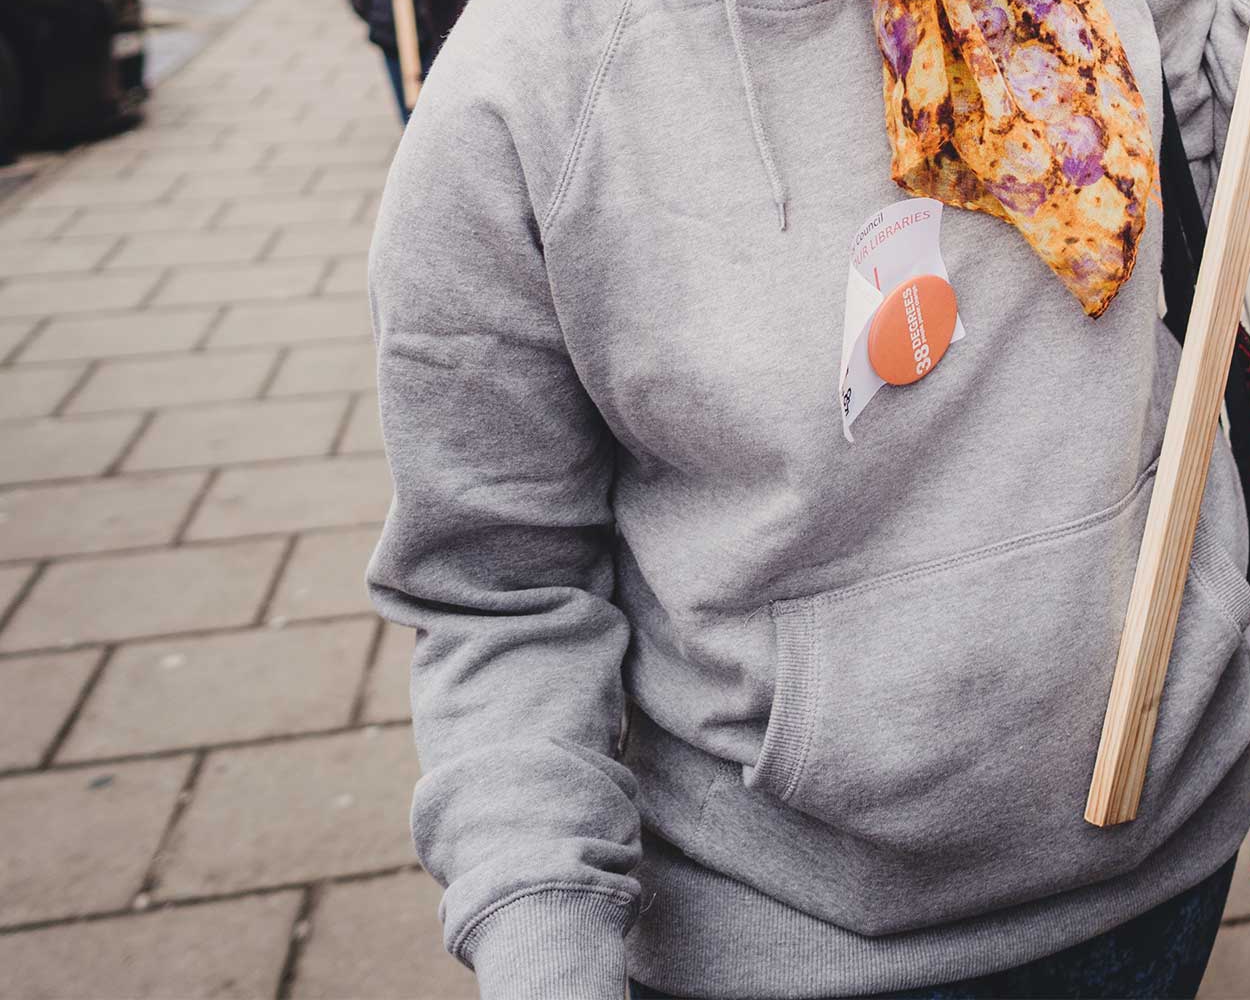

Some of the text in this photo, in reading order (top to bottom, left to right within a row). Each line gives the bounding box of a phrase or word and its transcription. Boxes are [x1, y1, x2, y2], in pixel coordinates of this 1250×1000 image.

[870, 210, 931, 251] LIBRARIES
[902, 287, 922, 350] DEGREES
[914, 343, 931, 375] 38
